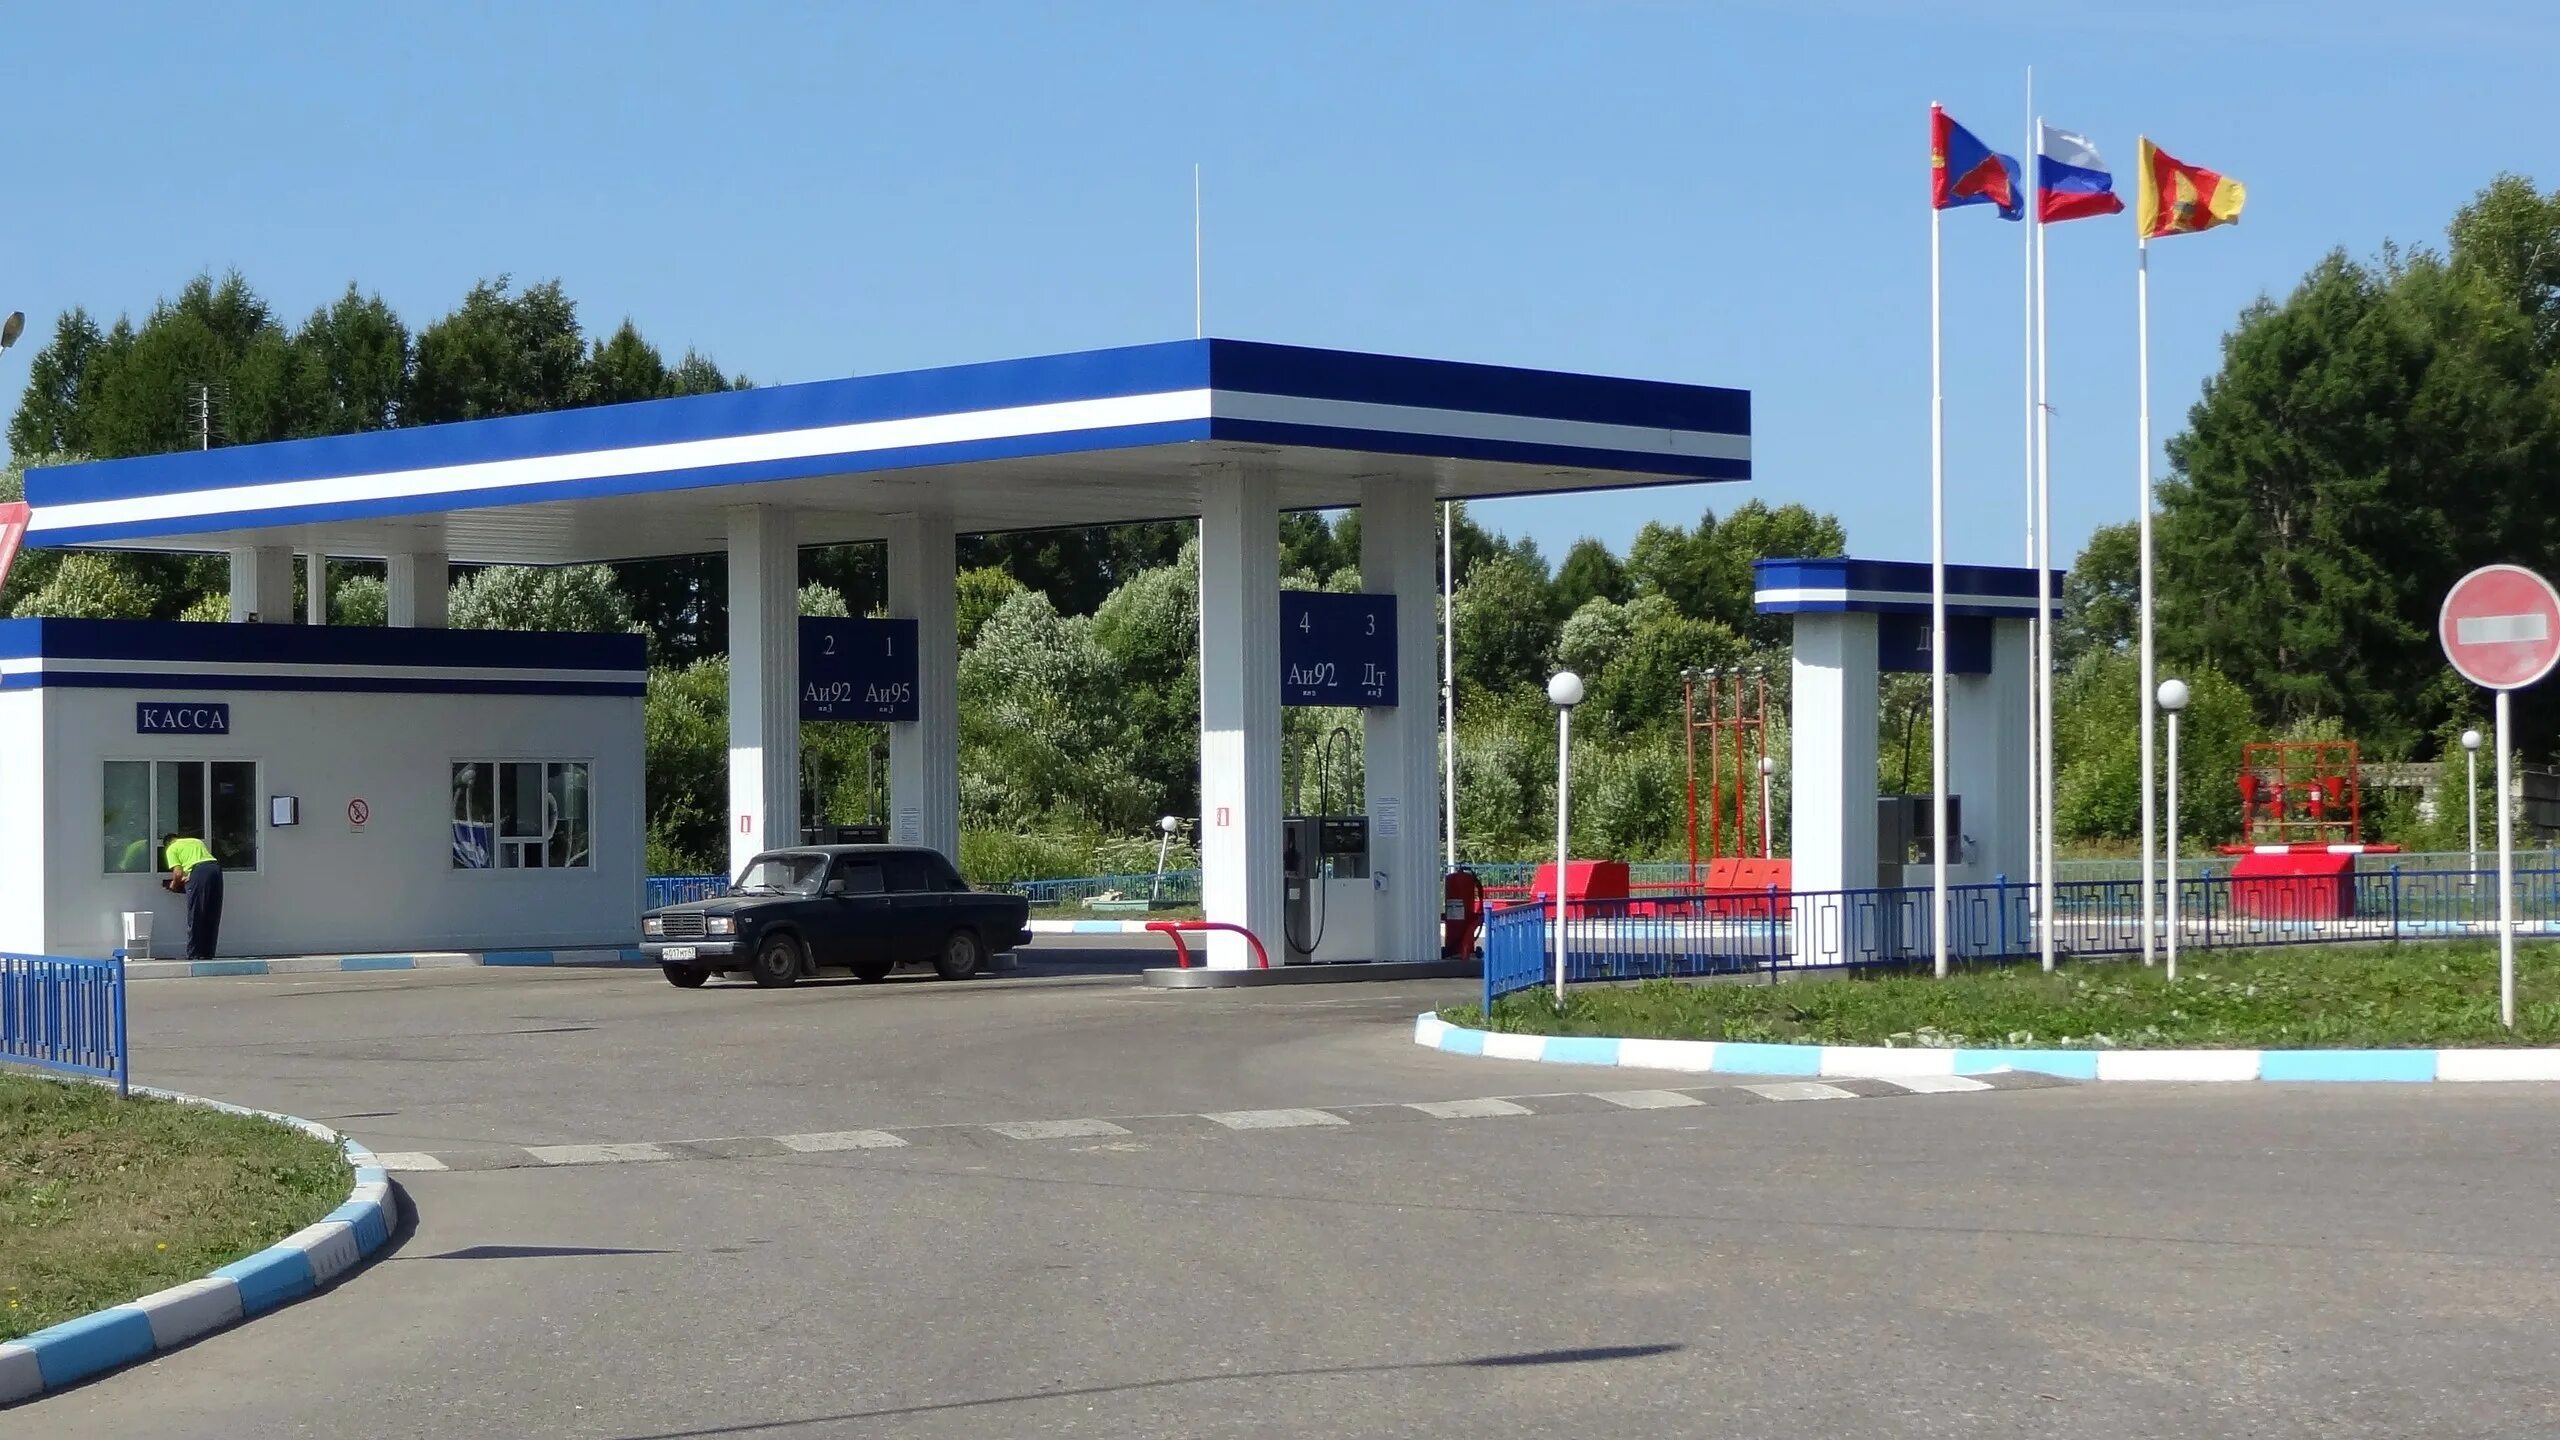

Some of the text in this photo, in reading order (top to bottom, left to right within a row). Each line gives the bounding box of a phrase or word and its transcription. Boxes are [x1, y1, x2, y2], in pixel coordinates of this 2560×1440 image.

[1299, 611, 1376, 636] 4 3
[822, 634, 893, 657] 2 1
[1286, 662, 1387, 687] Аи92 Дт
[803, 681, 911, 703] Аи92 Аи95
[143, 708, 225, 729] КАССА
